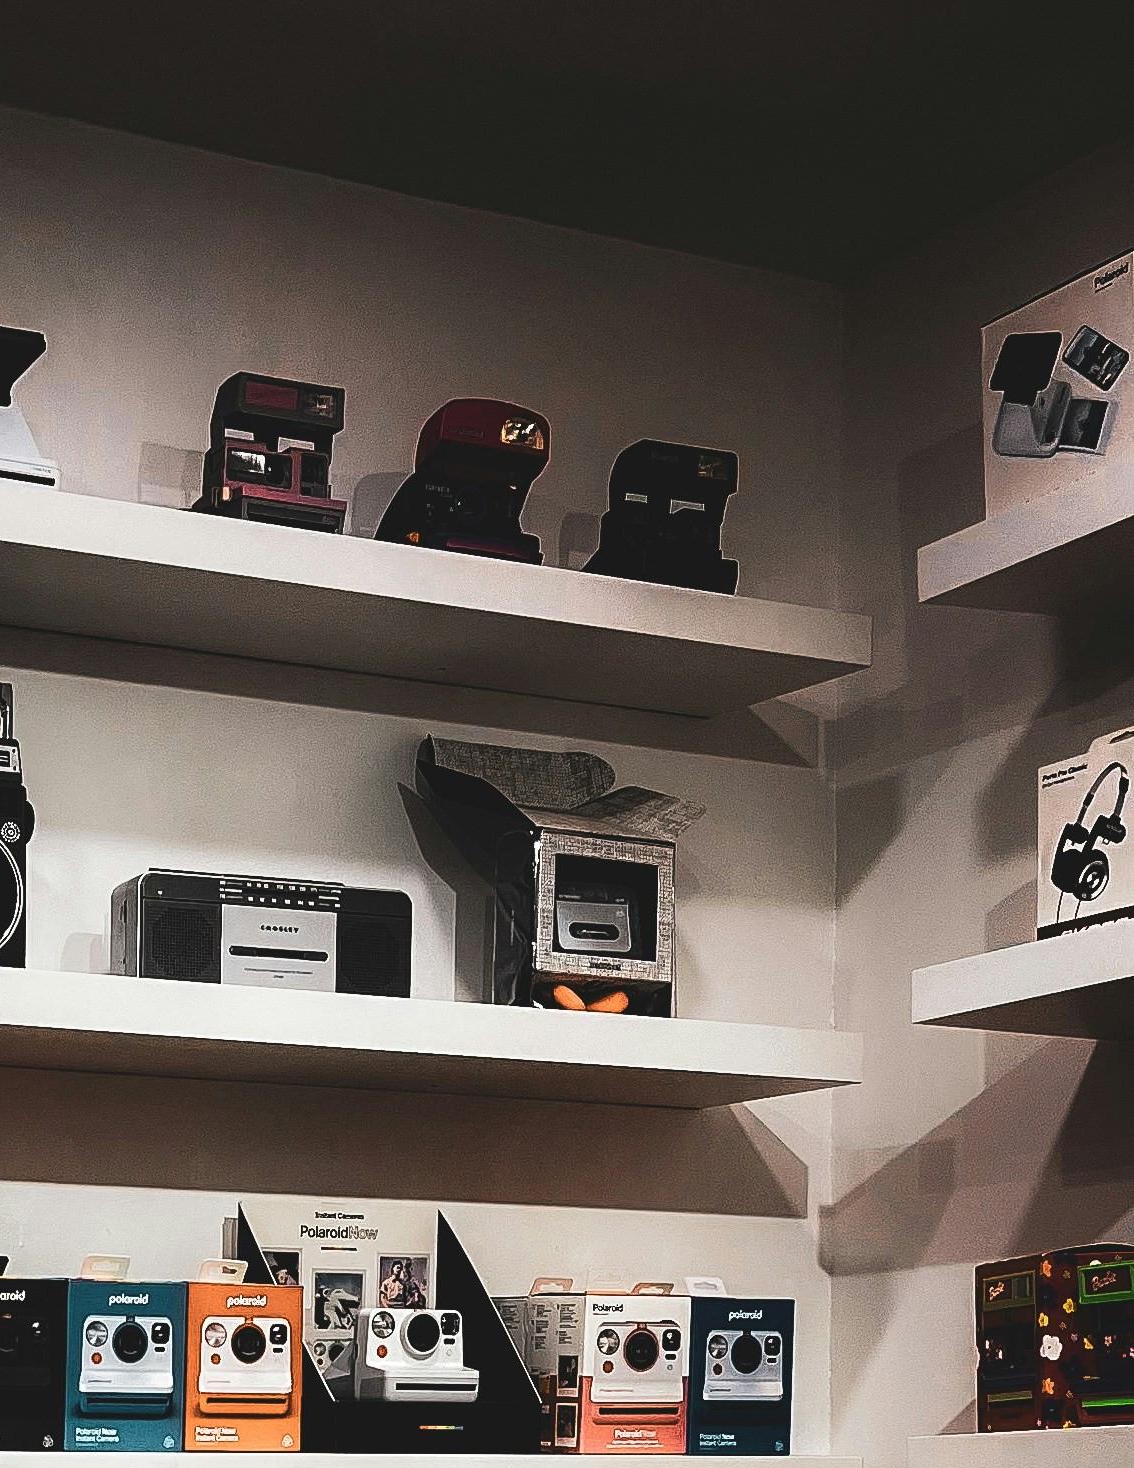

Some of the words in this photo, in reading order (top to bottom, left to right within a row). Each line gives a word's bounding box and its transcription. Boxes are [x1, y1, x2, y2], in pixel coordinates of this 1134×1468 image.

[260, 924, 300, 934] CROSLEY
[300, 1225, 379, 1240] PolaroidNow
[108, 1293, 149, 1306] polaroid
[226, 1294, 267, 1308] polaroid
[592, 1303, 624, 1313] Polaroid
[729, 1310, 763, 1321] polaroid
